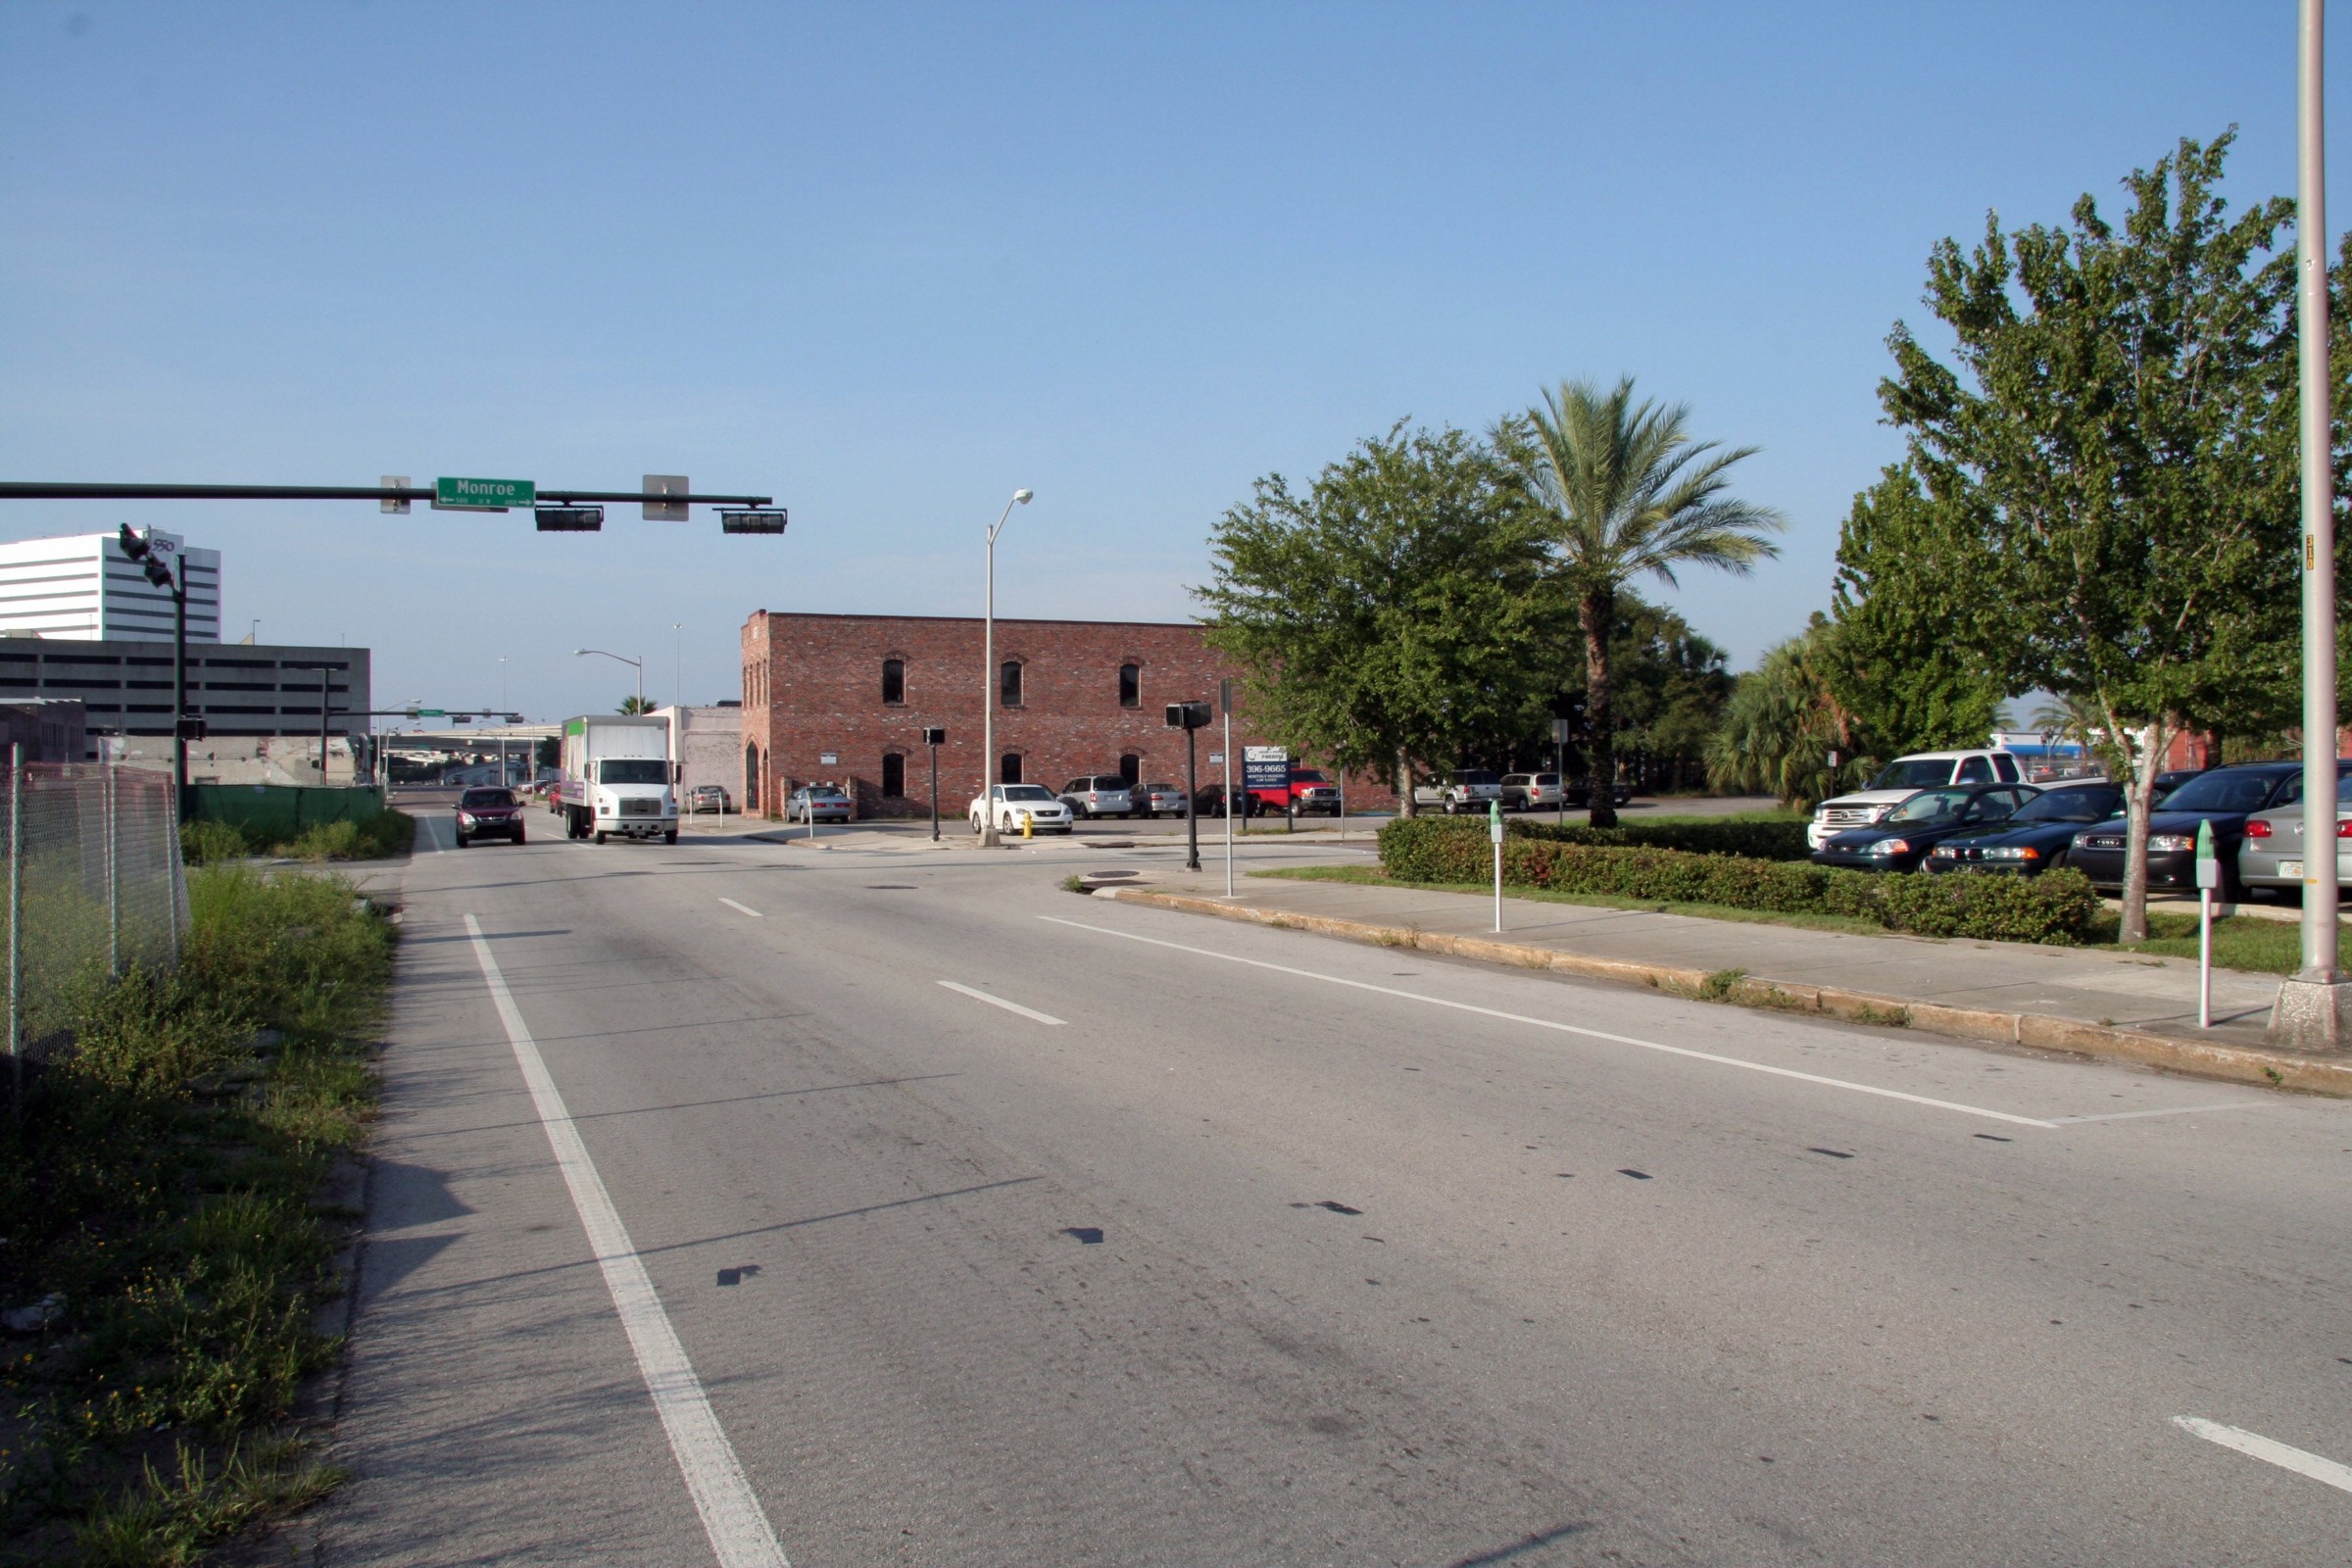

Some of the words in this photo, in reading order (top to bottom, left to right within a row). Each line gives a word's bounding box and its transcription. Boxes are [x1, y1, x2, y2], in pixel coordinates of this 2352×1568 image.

[457, 479, 515, 496] Monroe
[151, 539, 174, 552] 550
[1246, 764, 1286, 773] 396-9665
